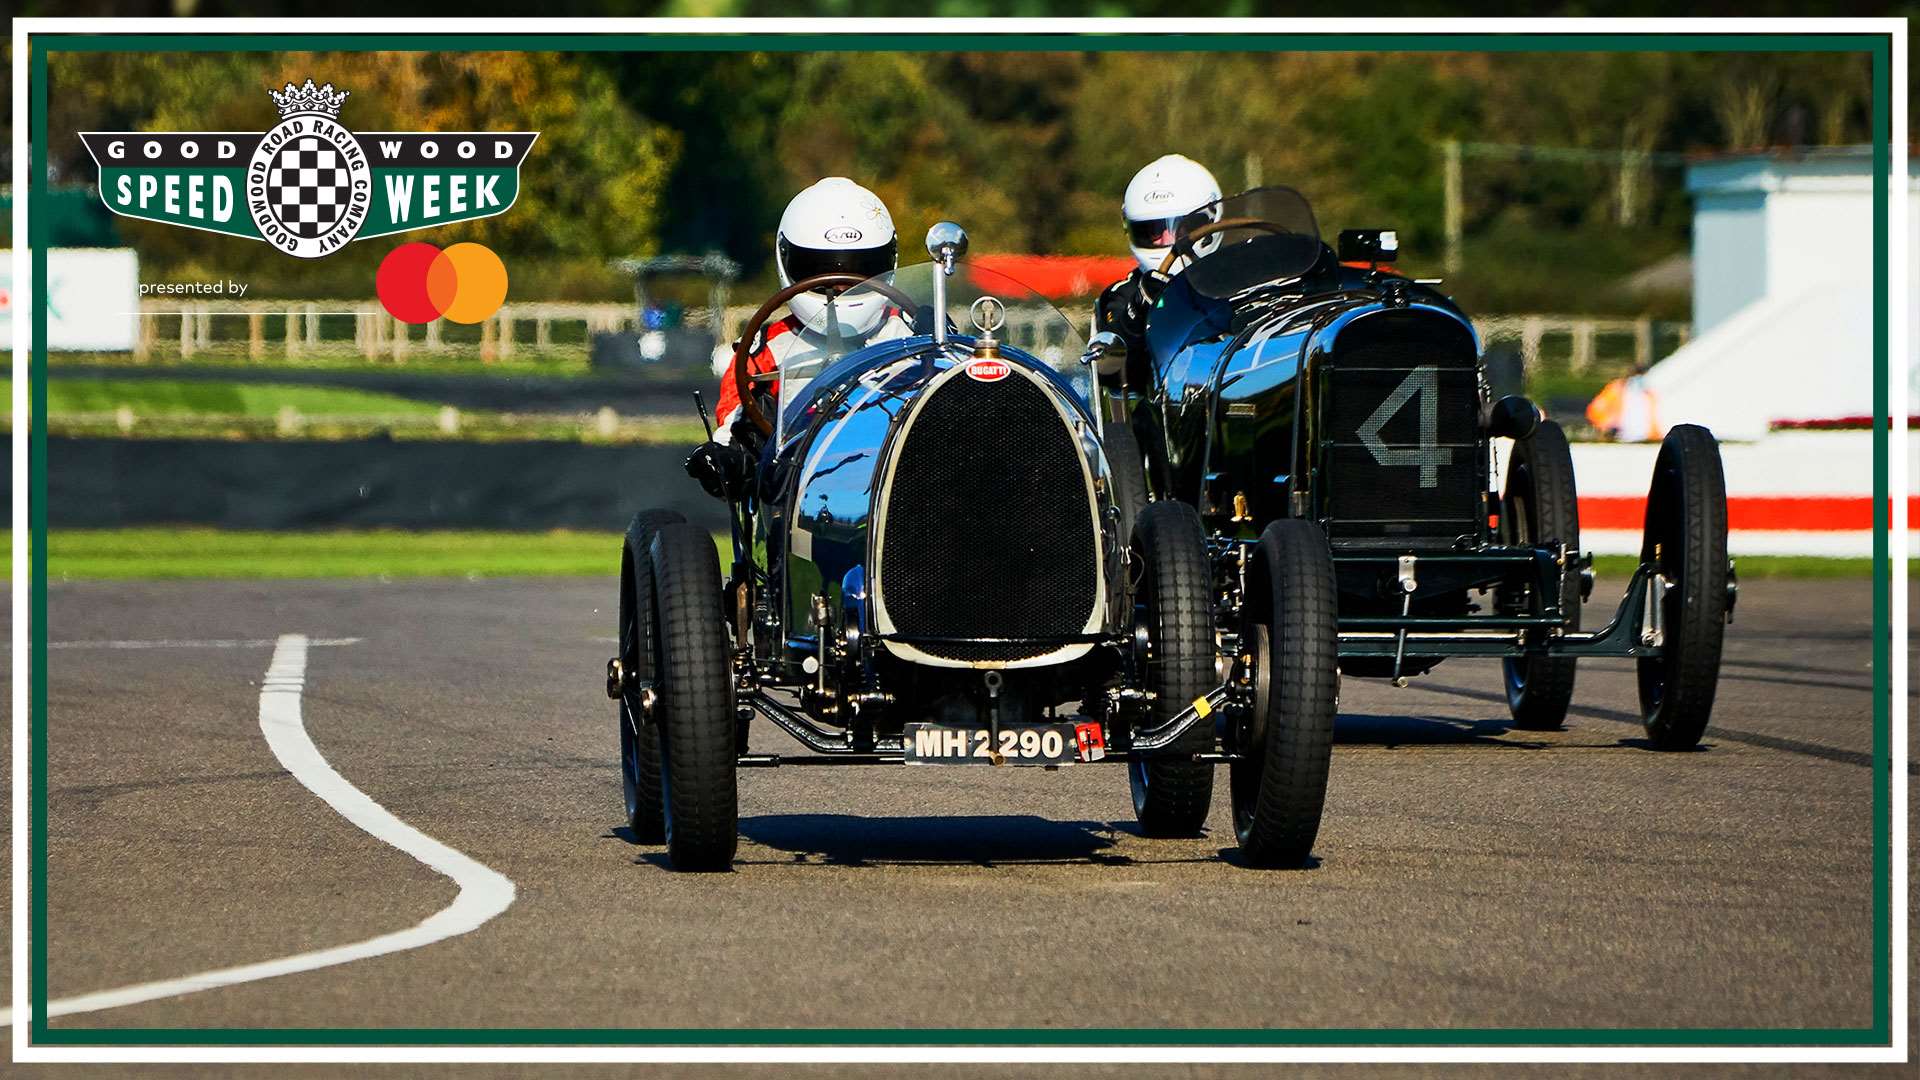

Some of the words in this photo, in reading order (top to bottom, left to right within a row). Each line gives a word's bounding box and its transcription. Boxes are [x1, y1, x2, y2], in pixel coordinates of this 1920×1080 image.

[971, 365, 1007, 376] BUGATTI
[1355, 365, 1452, 488] 4
[915, 730, 967, 757] MH
[973, 730, 1064, 759] 2290
